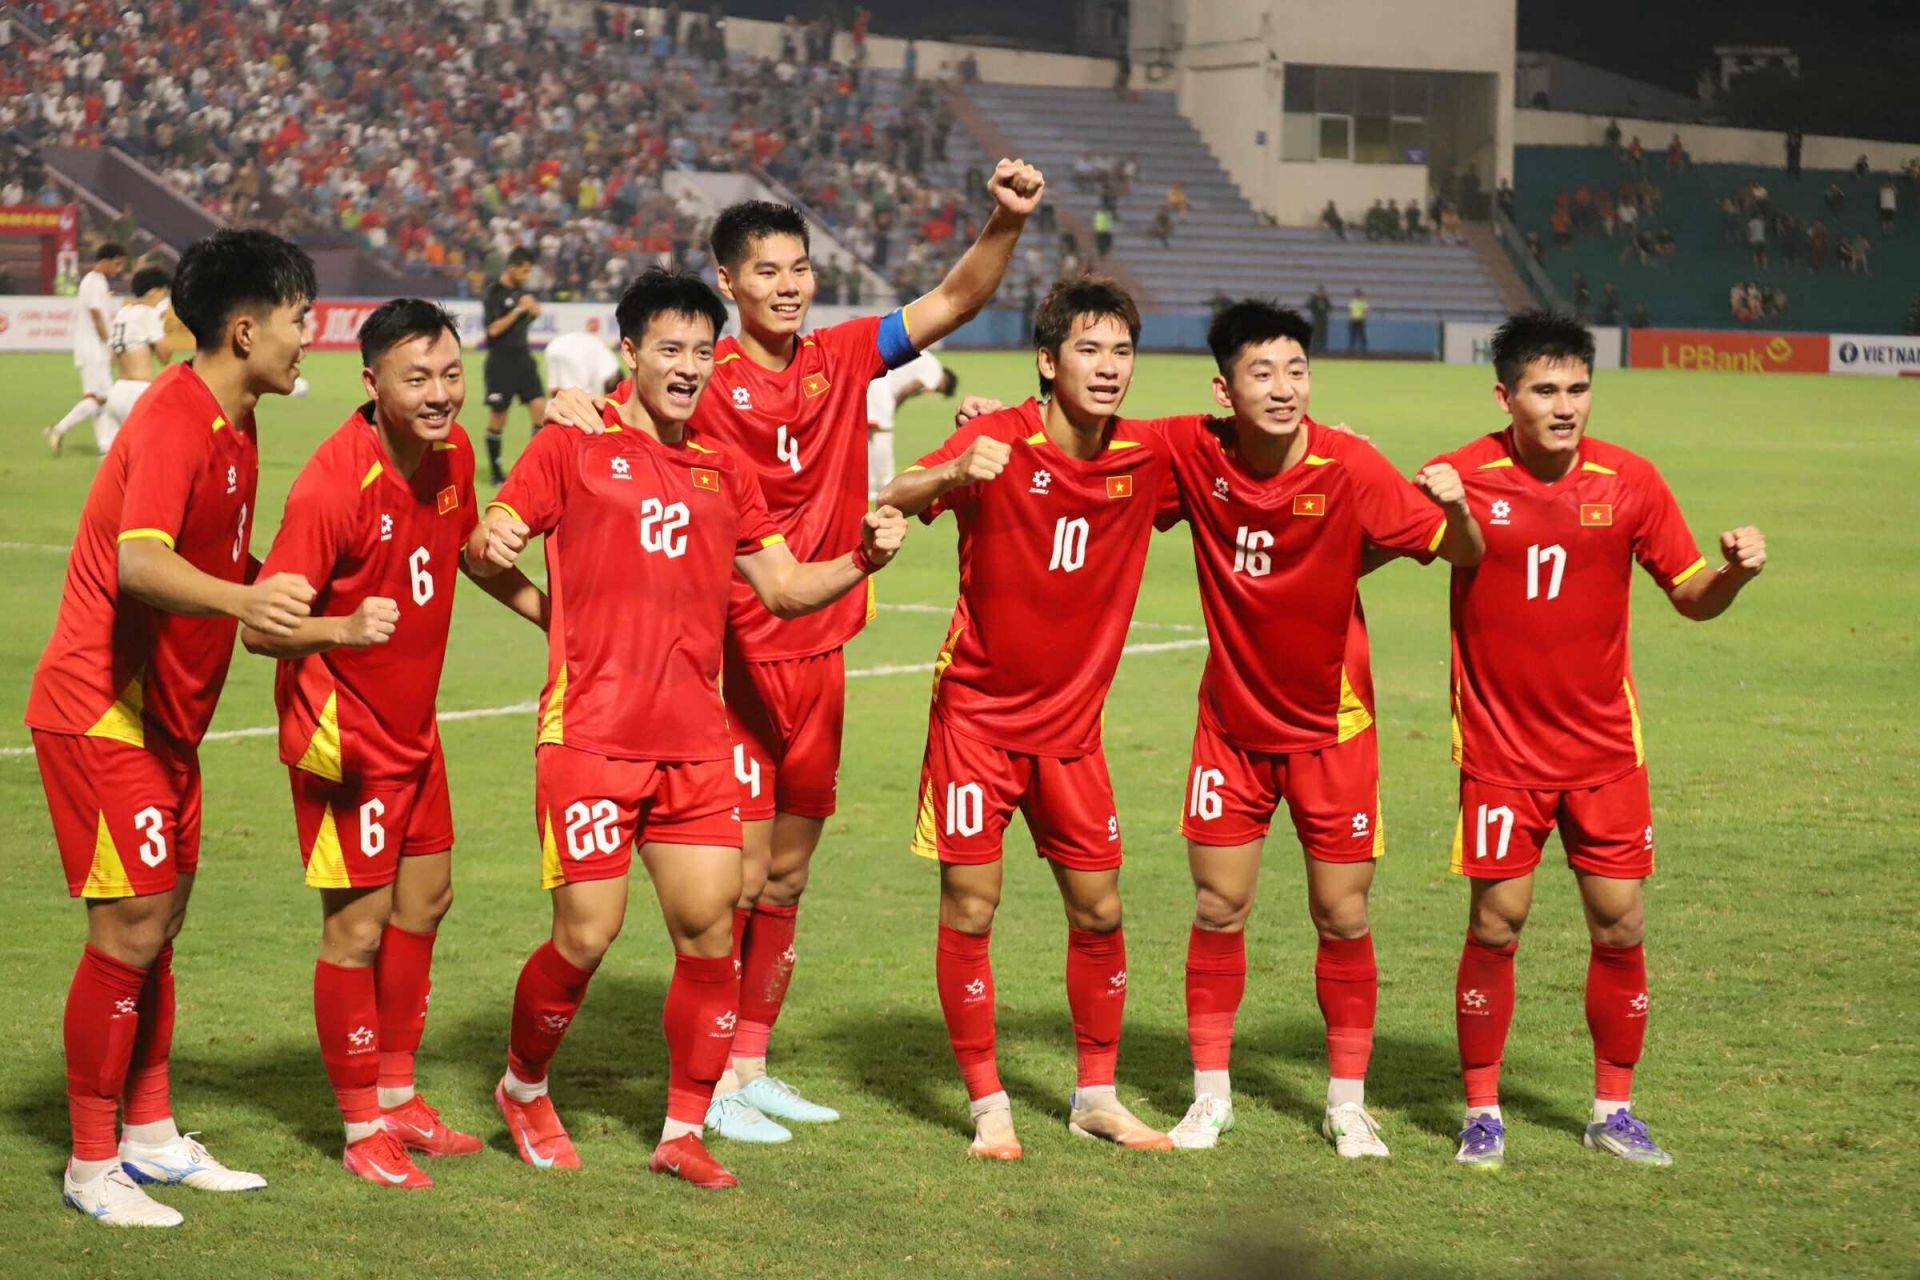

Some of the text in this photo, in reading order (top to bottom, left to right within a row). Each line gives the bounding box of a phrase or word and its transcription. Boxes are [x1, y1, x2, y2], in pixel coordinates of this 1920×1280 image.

[1662, 344, 1765, 373] LPBank
[776, 424, 802, 473] 4
[232, 502, 247, 563] 3
[640, 497, 690, 559] 22
[1048, 516, 1090, 573] 10
[1233, 525, 1275, 577] 16
[408, 545, 434, 606] 6
[1527, 543, 1567, 601] 17
[733, 742, 761, 799] 4
[1189, 764, 1226, 822] 16
[133, 805, 167, 868] 3
[359, 797, 385, 858] 6
[564, 799, 621, 861] 22
[945, 780, 984, 838] 10
[1476, 803, 1515, 860] 17
